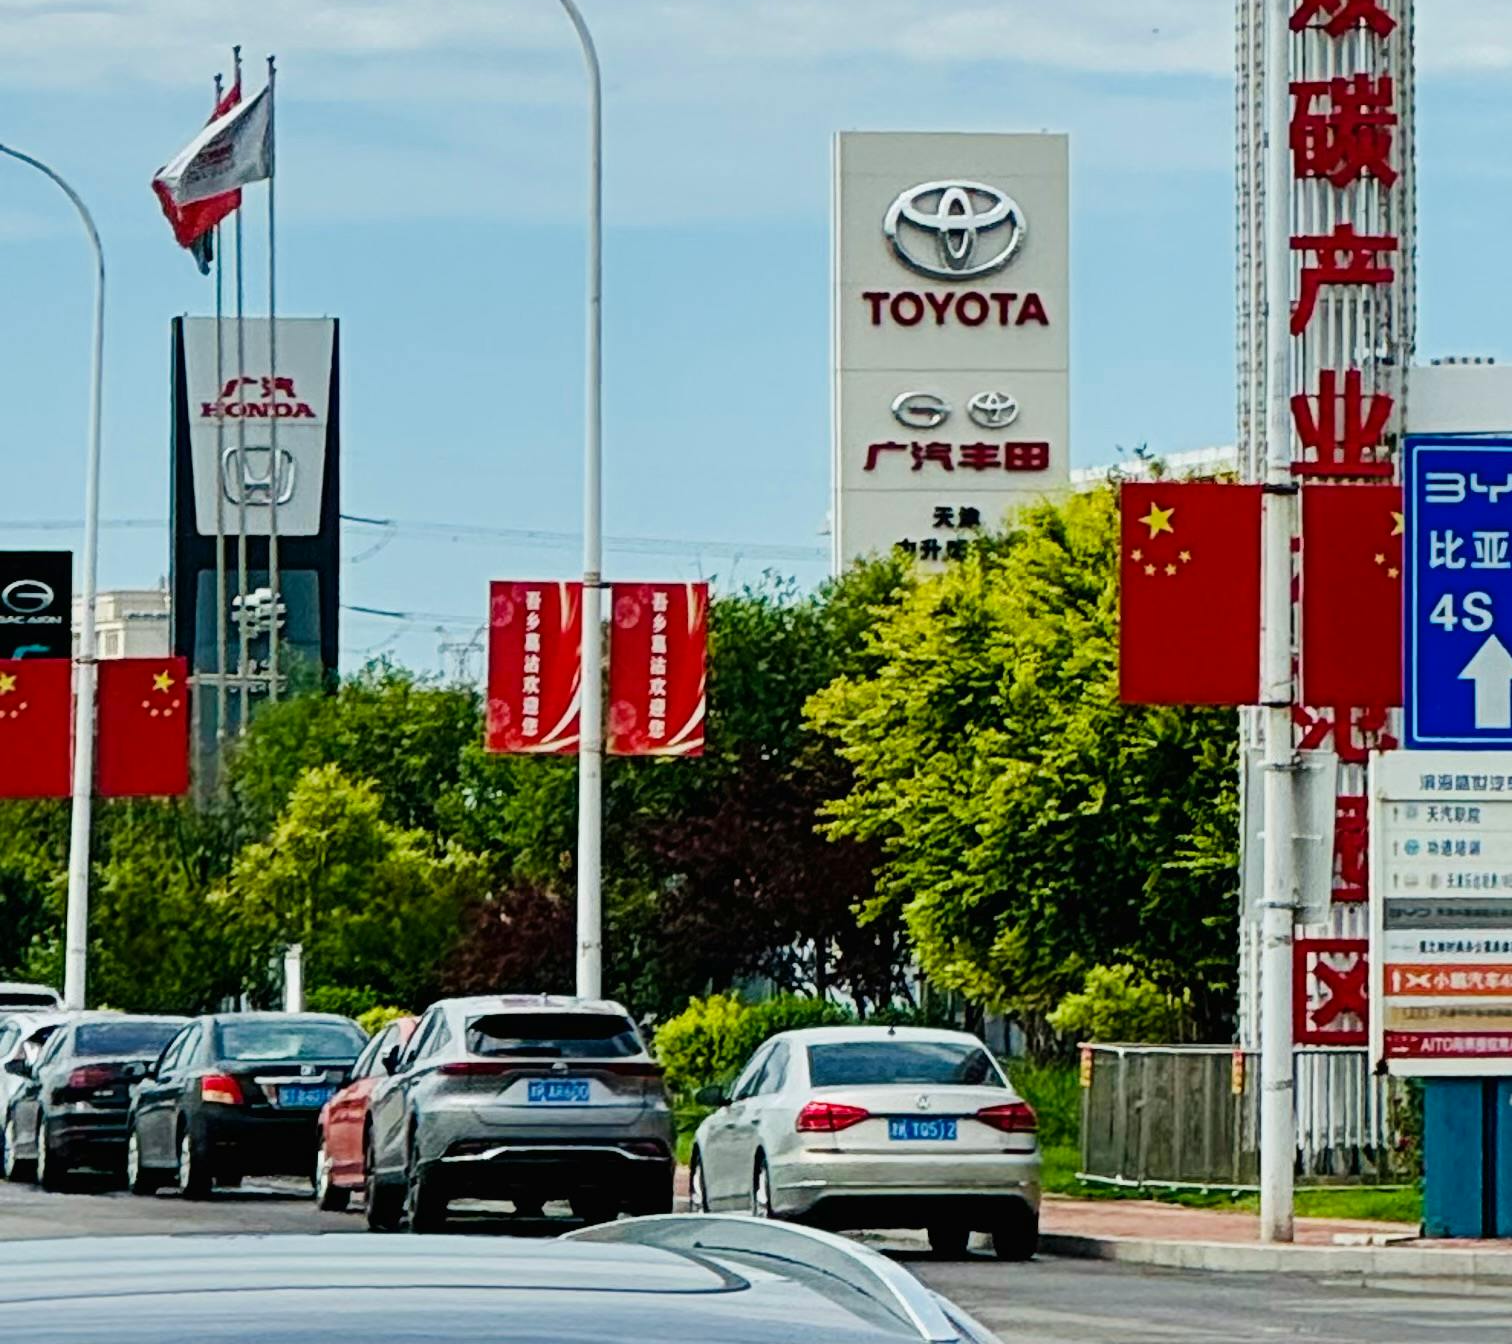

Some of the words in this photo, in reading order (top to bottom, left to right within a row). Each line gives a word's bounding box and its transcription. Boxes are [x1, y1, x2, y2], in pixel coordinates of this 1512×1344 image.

[862, 291, 1050, 328] TOYOTA
[201, 402, 317, 418] HONDA
[863, 441, 1050, 472] 广汽丰田
[932, 506, 981, 528] 天津
[1429, 591, 1494, 632] 4S
